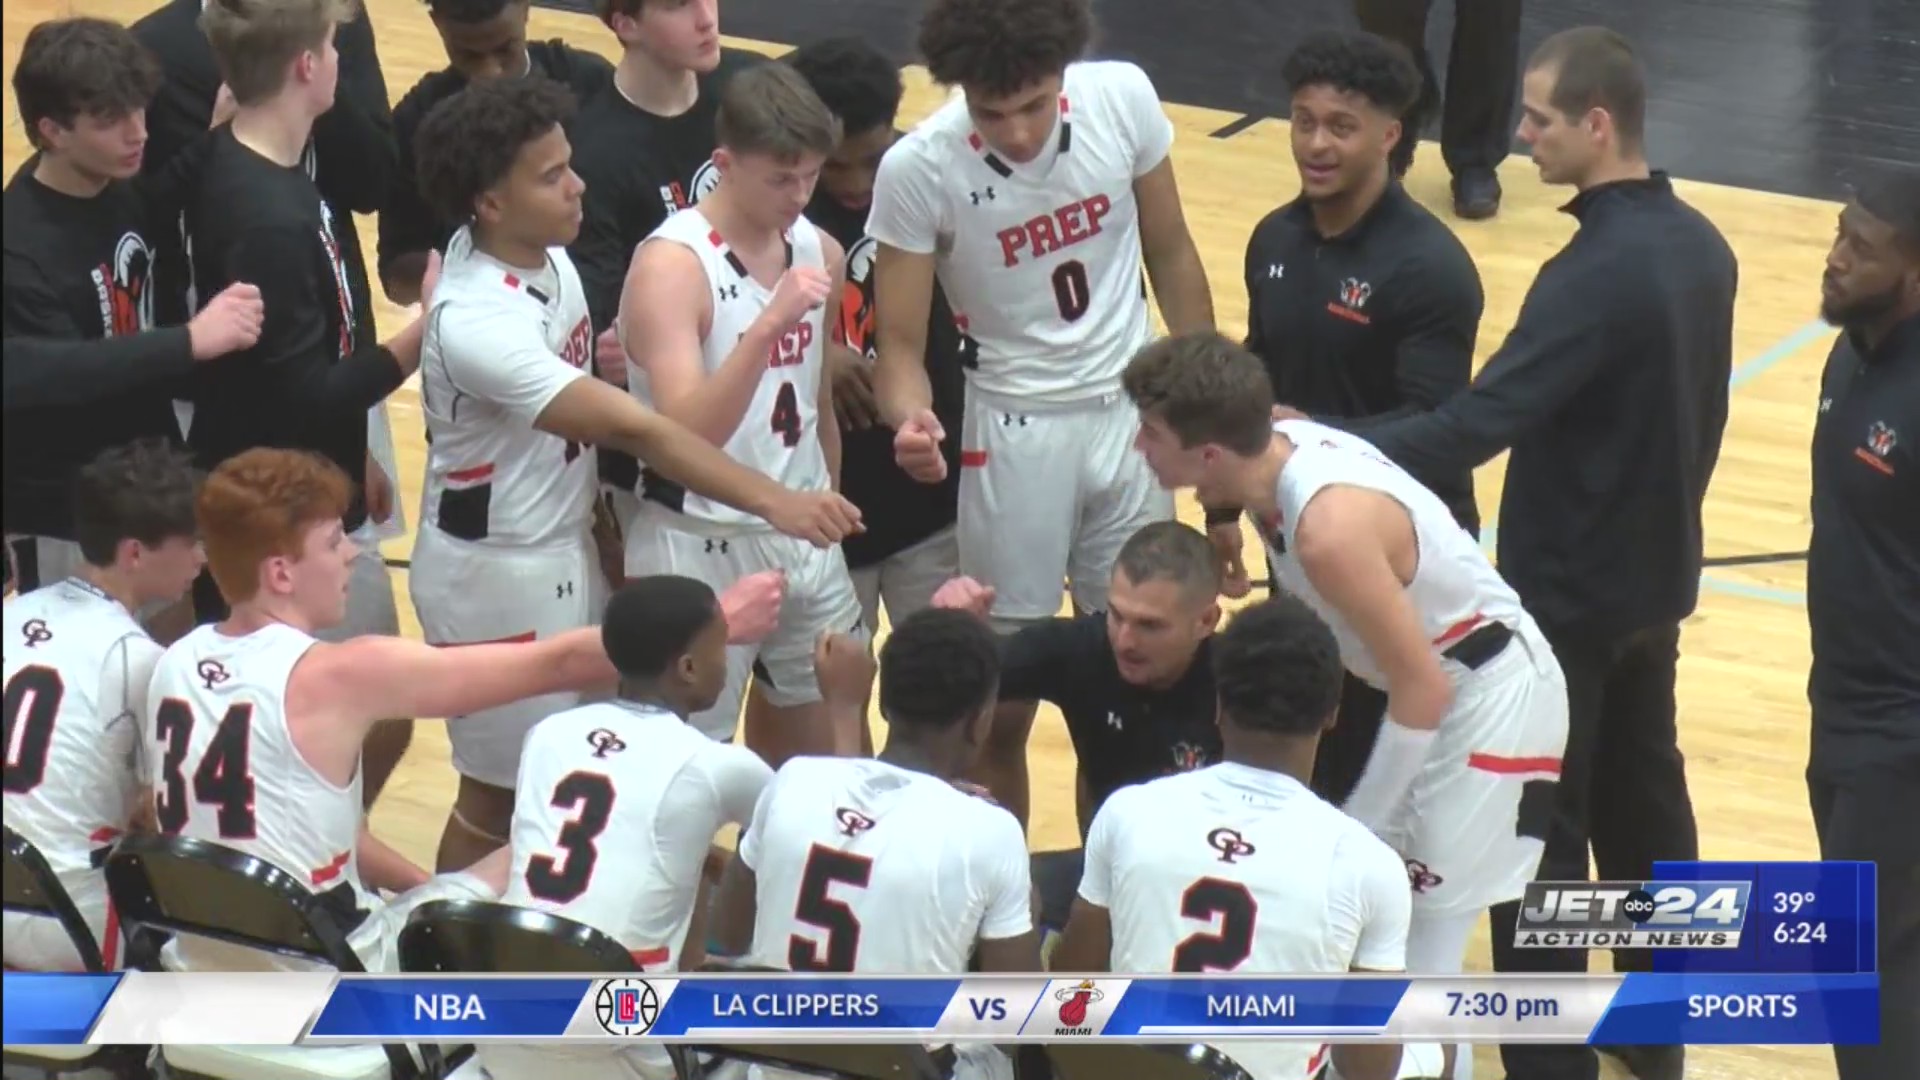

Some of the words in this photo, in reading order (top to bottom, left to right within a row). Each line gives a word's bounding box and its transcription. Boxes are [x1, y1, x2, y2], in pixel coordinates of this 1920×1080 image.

[996, 193, 1111, 268] PREP
[1051, 259, 1090, 323] 0
[770, 381, 802, 448] 4
[156, 696, 256, 839] 34
[525, 770, 617, 905] 3
[788, 840, 874, 972] 5
[1172, 876, 1258, 972] 2
